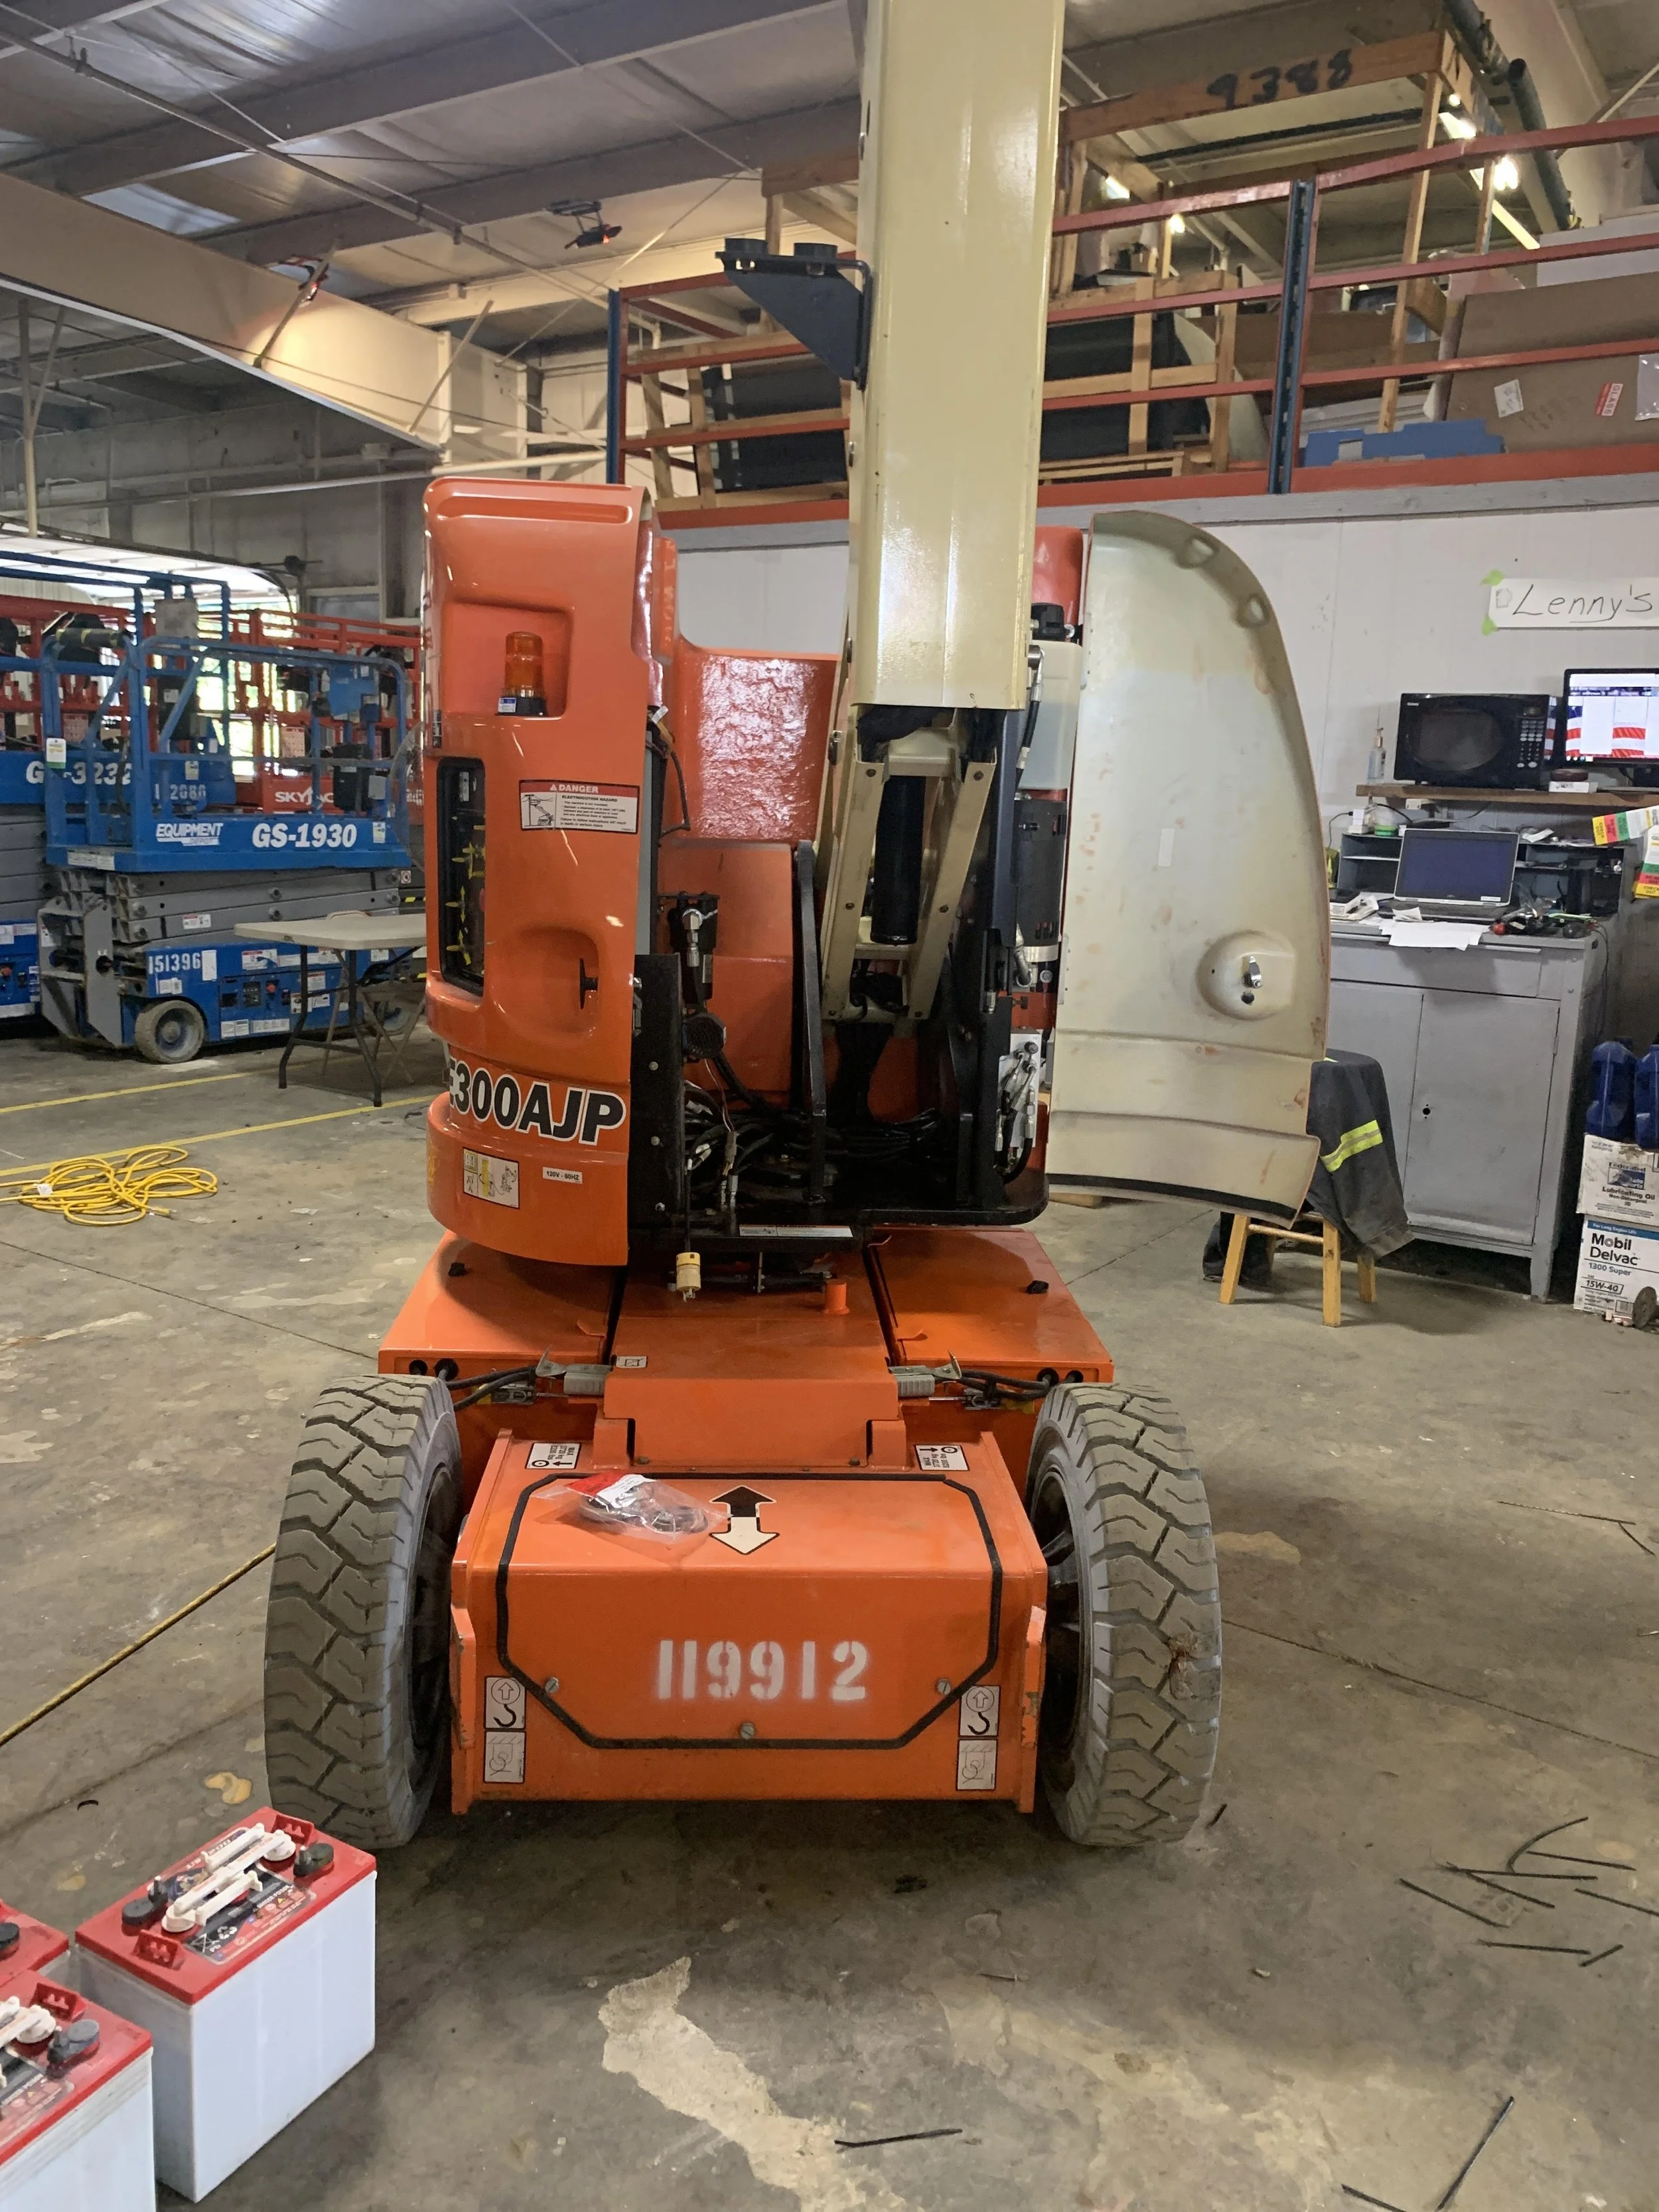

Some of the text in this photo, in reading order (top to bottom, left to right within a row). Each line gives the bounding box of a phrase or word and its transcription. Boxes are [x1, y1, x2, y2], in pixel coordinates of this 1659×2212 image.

[1512, 584, 1652, 623] Lenny's
[26, 761, 133, 784] G-3232
[275, 786, 334, 805] SKYJC
[559, 784, 599, 794] DANGER
[156, 823, 224, 838] EQUIPMENT
[252, 823, 357, 848] GS-1930
[148, 952, 201, 975] 151396
[1602, 1186, 1643, 1199] Lubricating
[1591, 1232, 1632, 1250] Mobil
[1590, 1246, 1638, 1266] Delvac
[1589, 1262, 1632, 1276] 1300 Super
[1586, 1280, 1619, 1292] 15W-40
[658, 1640, 867, 1701] 119912
